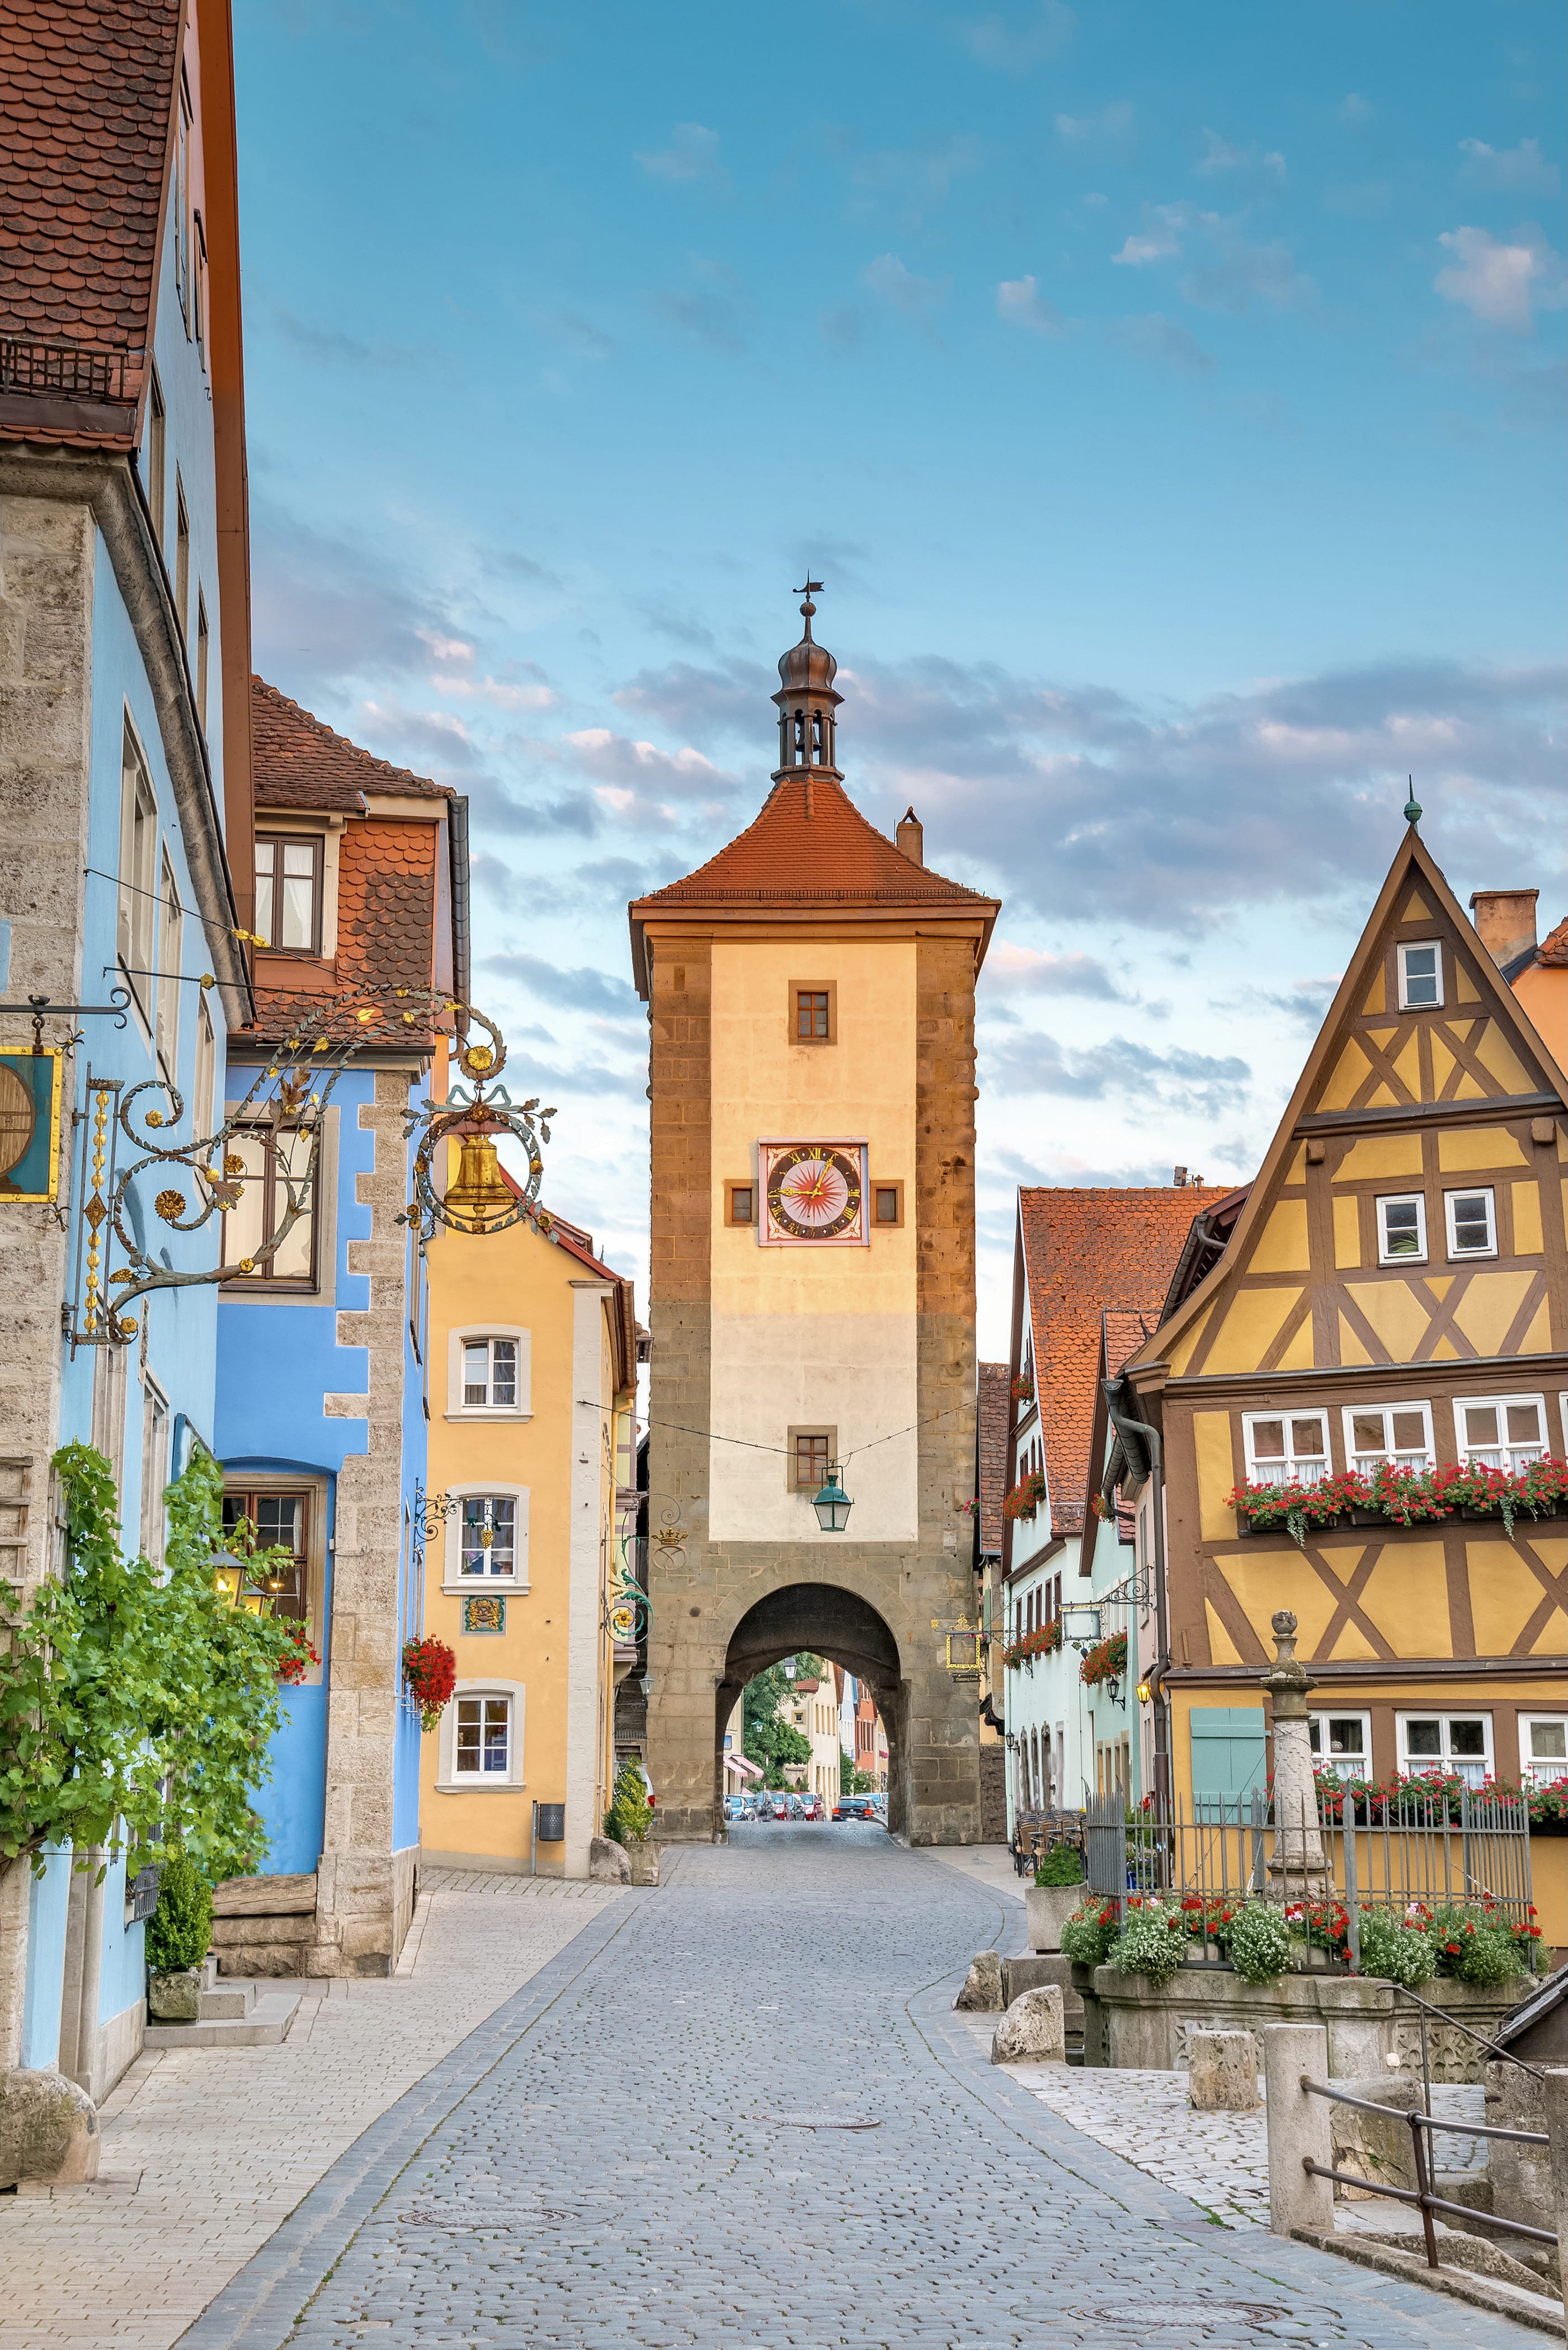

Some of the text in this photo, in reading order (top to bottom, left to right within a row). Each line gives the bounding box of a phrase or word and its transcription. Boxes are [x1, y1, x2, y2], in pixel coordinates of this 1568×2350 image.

[787, 1151, 802, 1164] XI
[807, 1148, 822, 1160] XII
[842, 1206, 857, 1220] IIII
